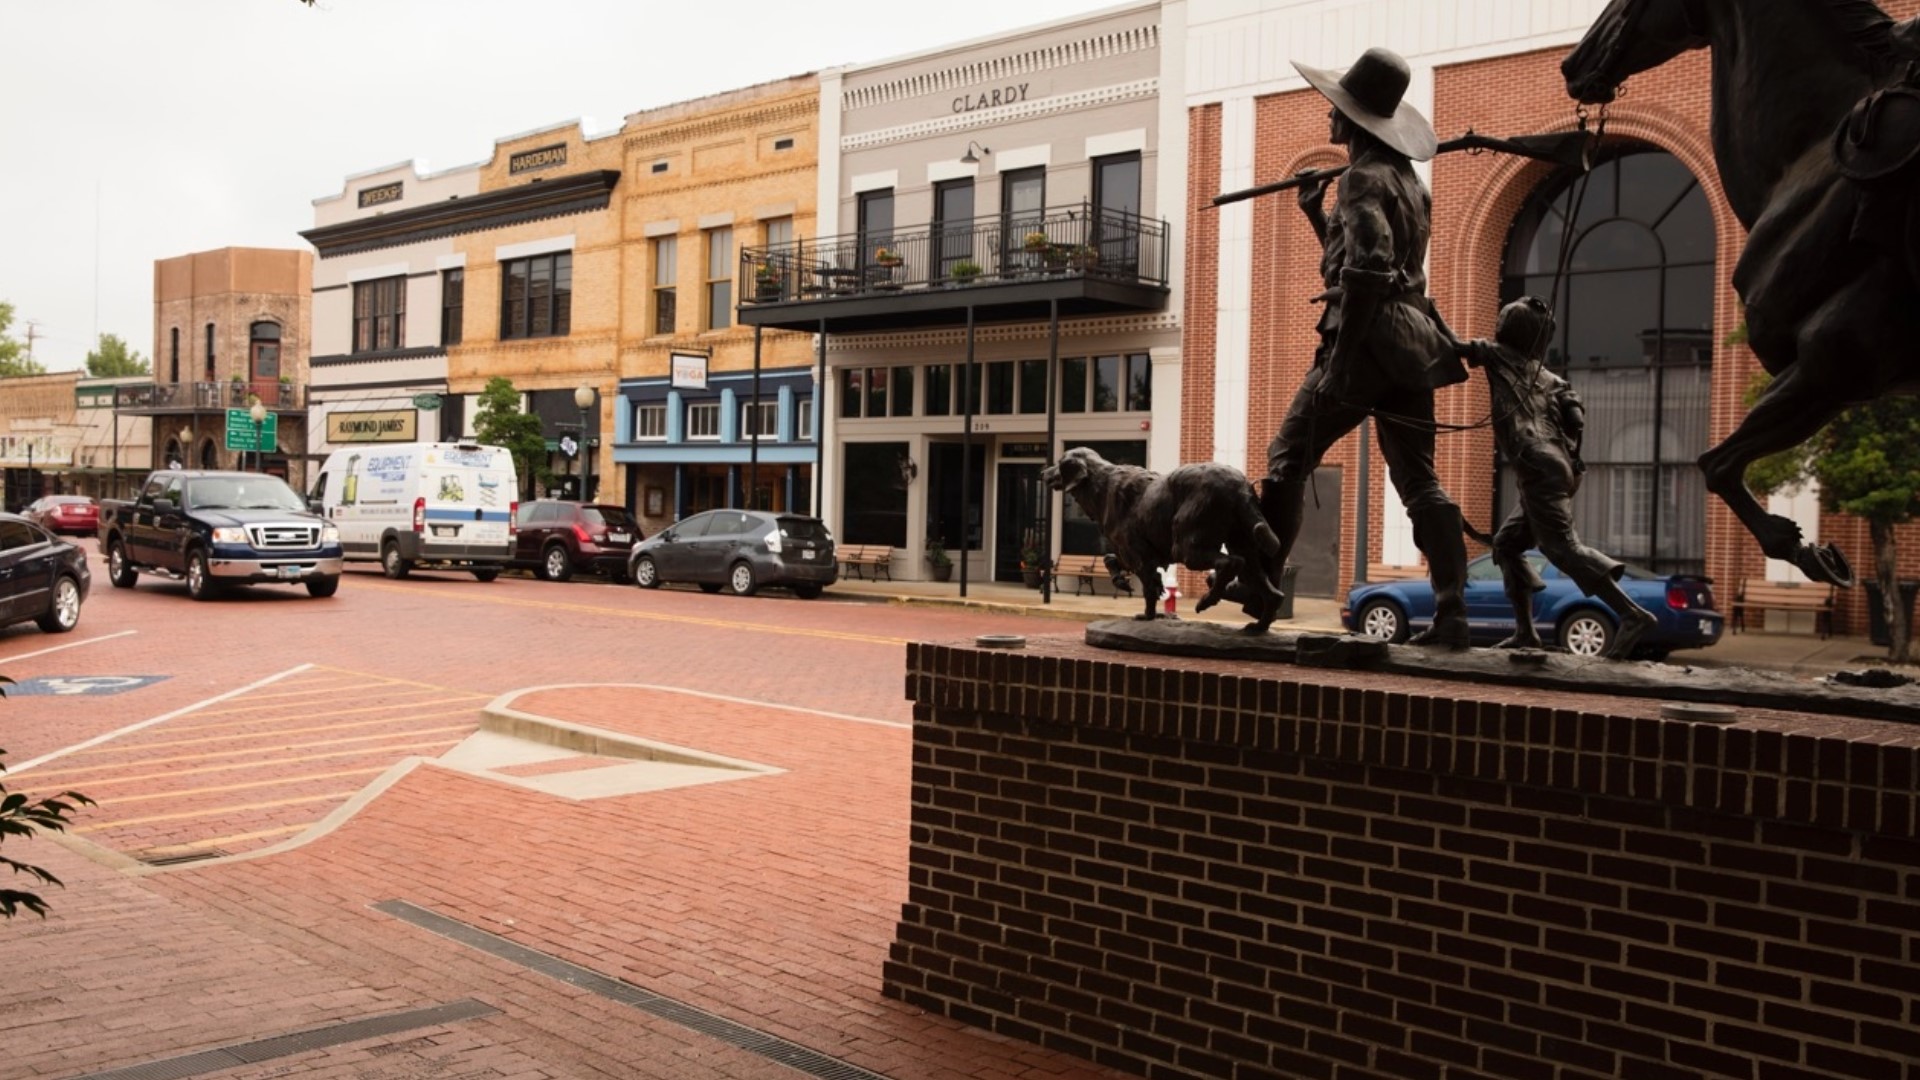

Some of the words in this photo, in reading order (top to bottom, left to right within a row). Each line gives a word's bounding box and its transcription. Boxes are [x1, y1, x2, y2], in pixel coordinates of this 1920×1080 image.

[952, 82, 1029, 113] CLARDY
[512, 147, 566, 171] HARDEMAN
[339, 420, 377, 433] RAYMOND
[377, 419, 403, 436] JAMES
[367, 455, 412, 472] EQUIPMENT
[444, 451, 493, 463] EQUIPMENT
